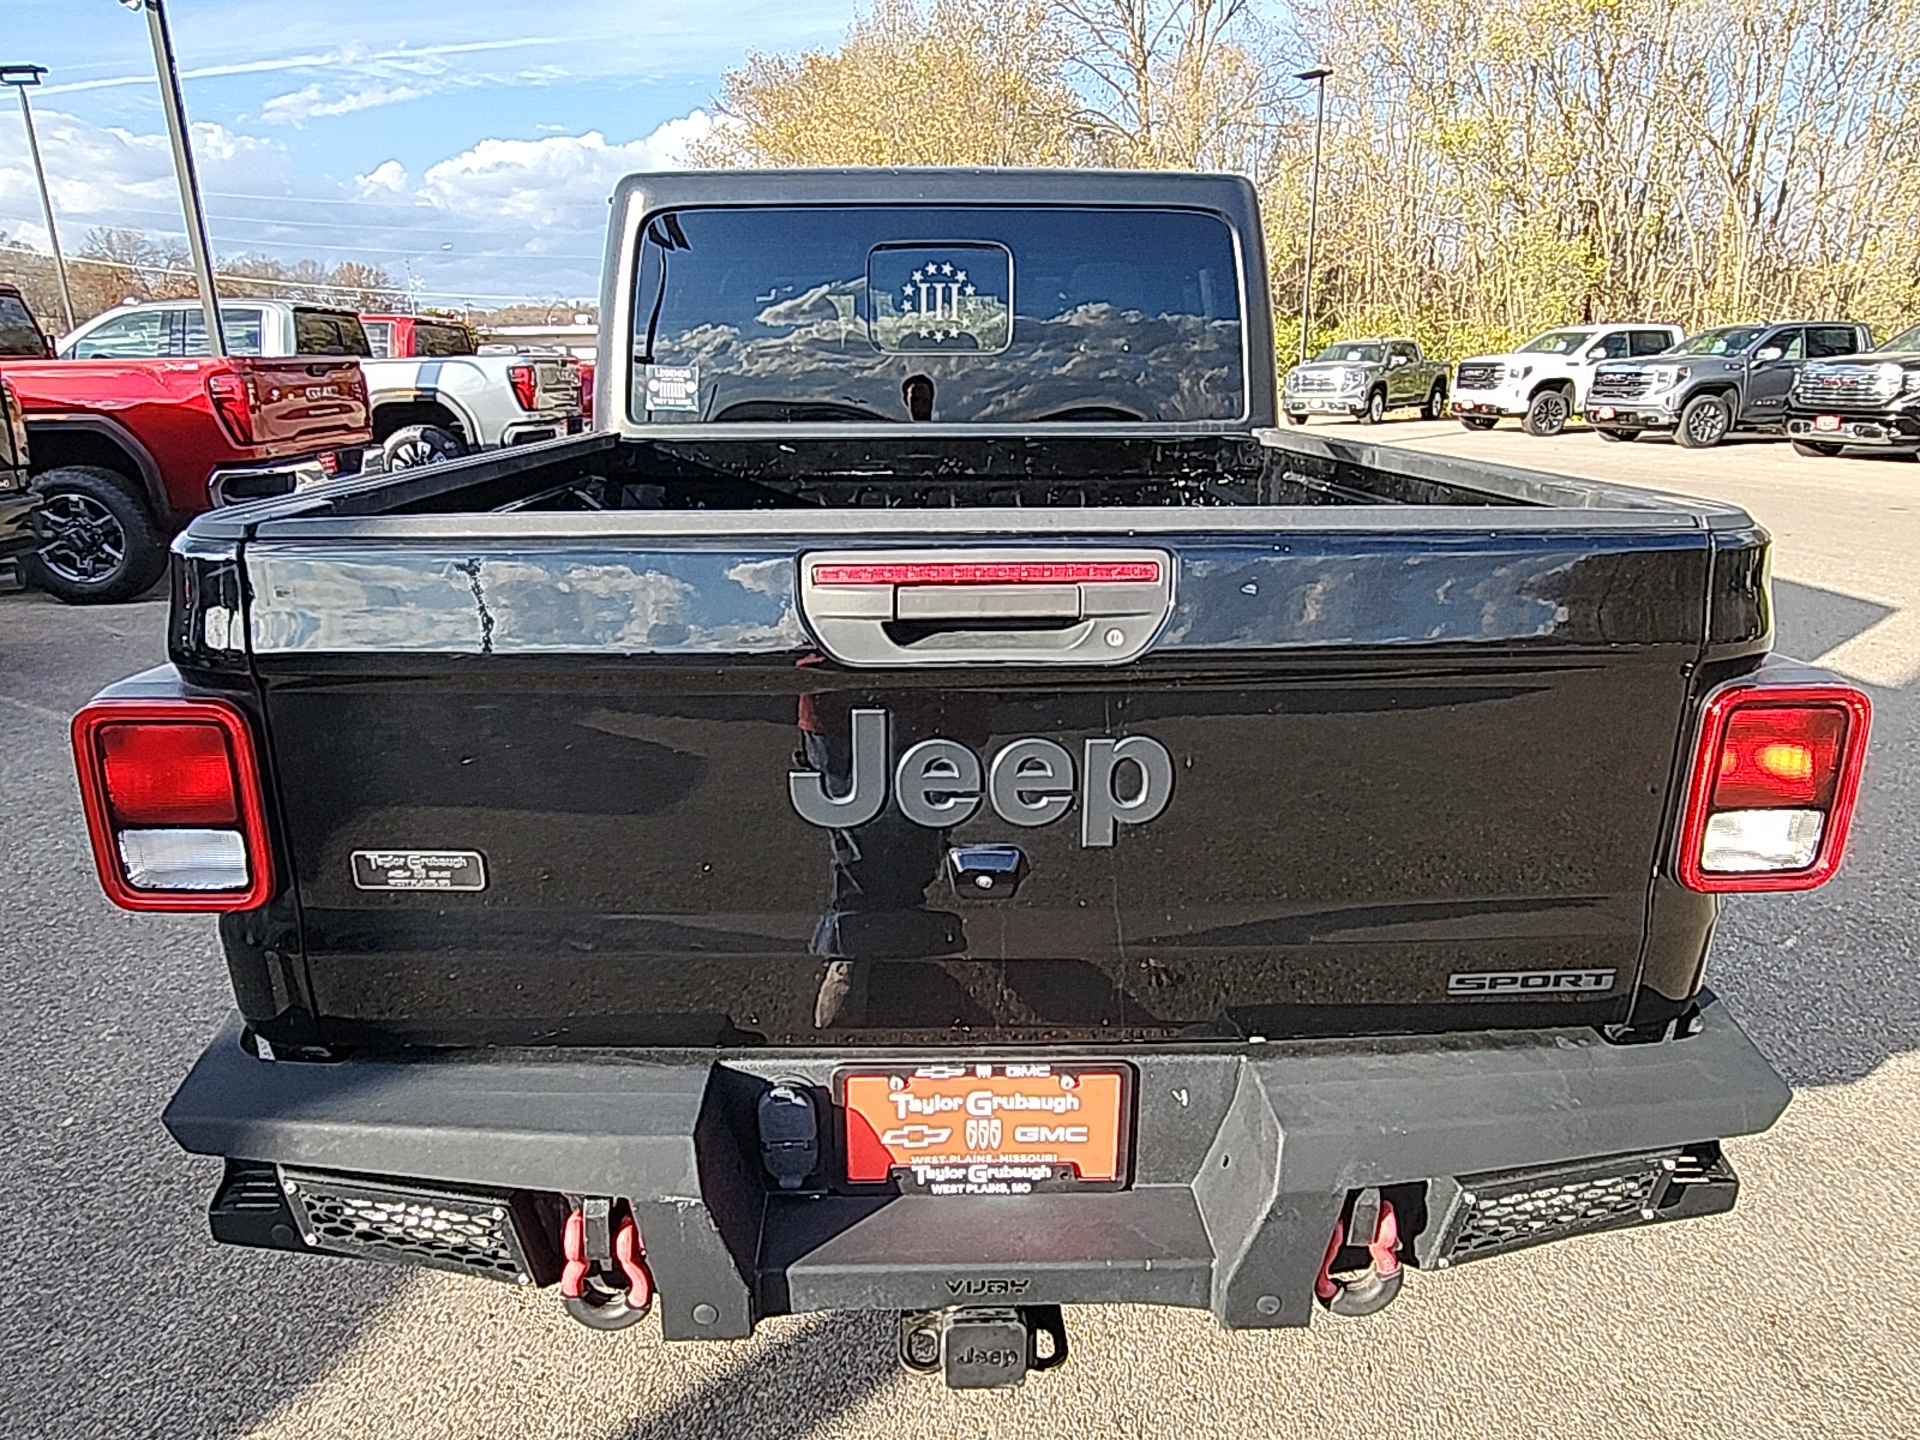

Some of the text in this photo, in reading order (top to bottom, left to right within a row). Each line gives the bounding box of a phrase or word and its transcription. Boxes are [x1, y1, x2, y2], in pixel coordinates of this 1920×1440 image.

[788, 708, 1173, 848] Jeep
[1454, 972, 1615, 991] SPORT
[1005, 1063, 1051, 1078] GMC
[888, 1090, 1081, 1120] Taylor Grubaugh
[1014, 1126, 1089, 1143] GMC
[999, 1153, 1059, 1164] MISSOURI
[911, 1164, 1052, 1186] Taylor Grubaugh
[930, 1183, 1032, 1195] WEST PLAINS, MO
[956, 1347, 1019, 1368] Jeep
